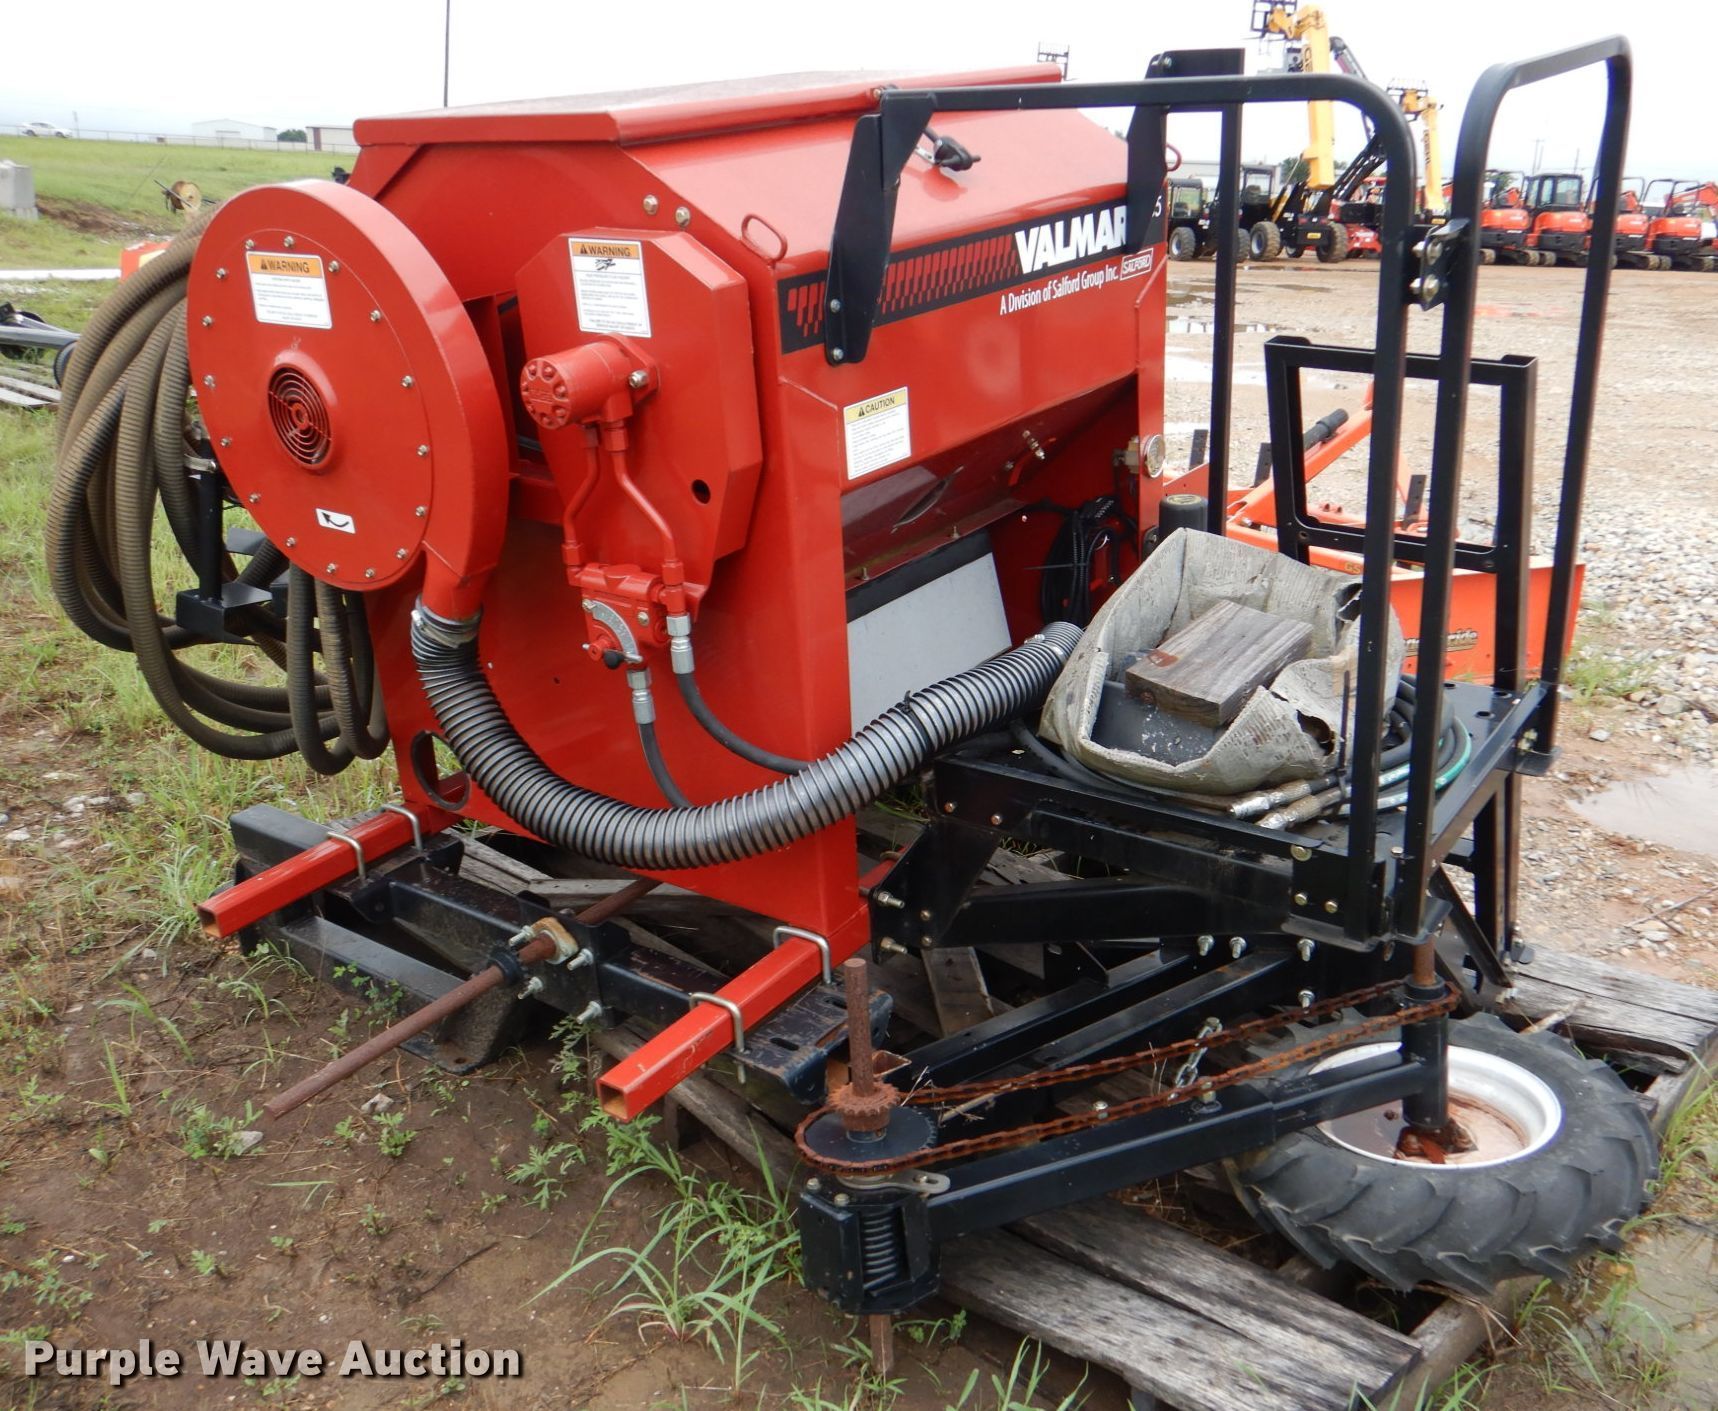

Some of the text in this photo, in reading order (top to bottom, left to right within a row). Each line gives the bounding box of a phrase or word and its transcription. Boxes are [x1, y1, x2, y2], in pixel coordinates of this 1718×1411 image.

[1014, 205, 1127, 275] VALMAR
[589, 245, 631, 257] WARNING
[268, 260, 310, 273] WARNING
[1000, 264, 1119, 315] A Division of Salford Group Inc.
[865, 396, 896, 414] CAUTION
